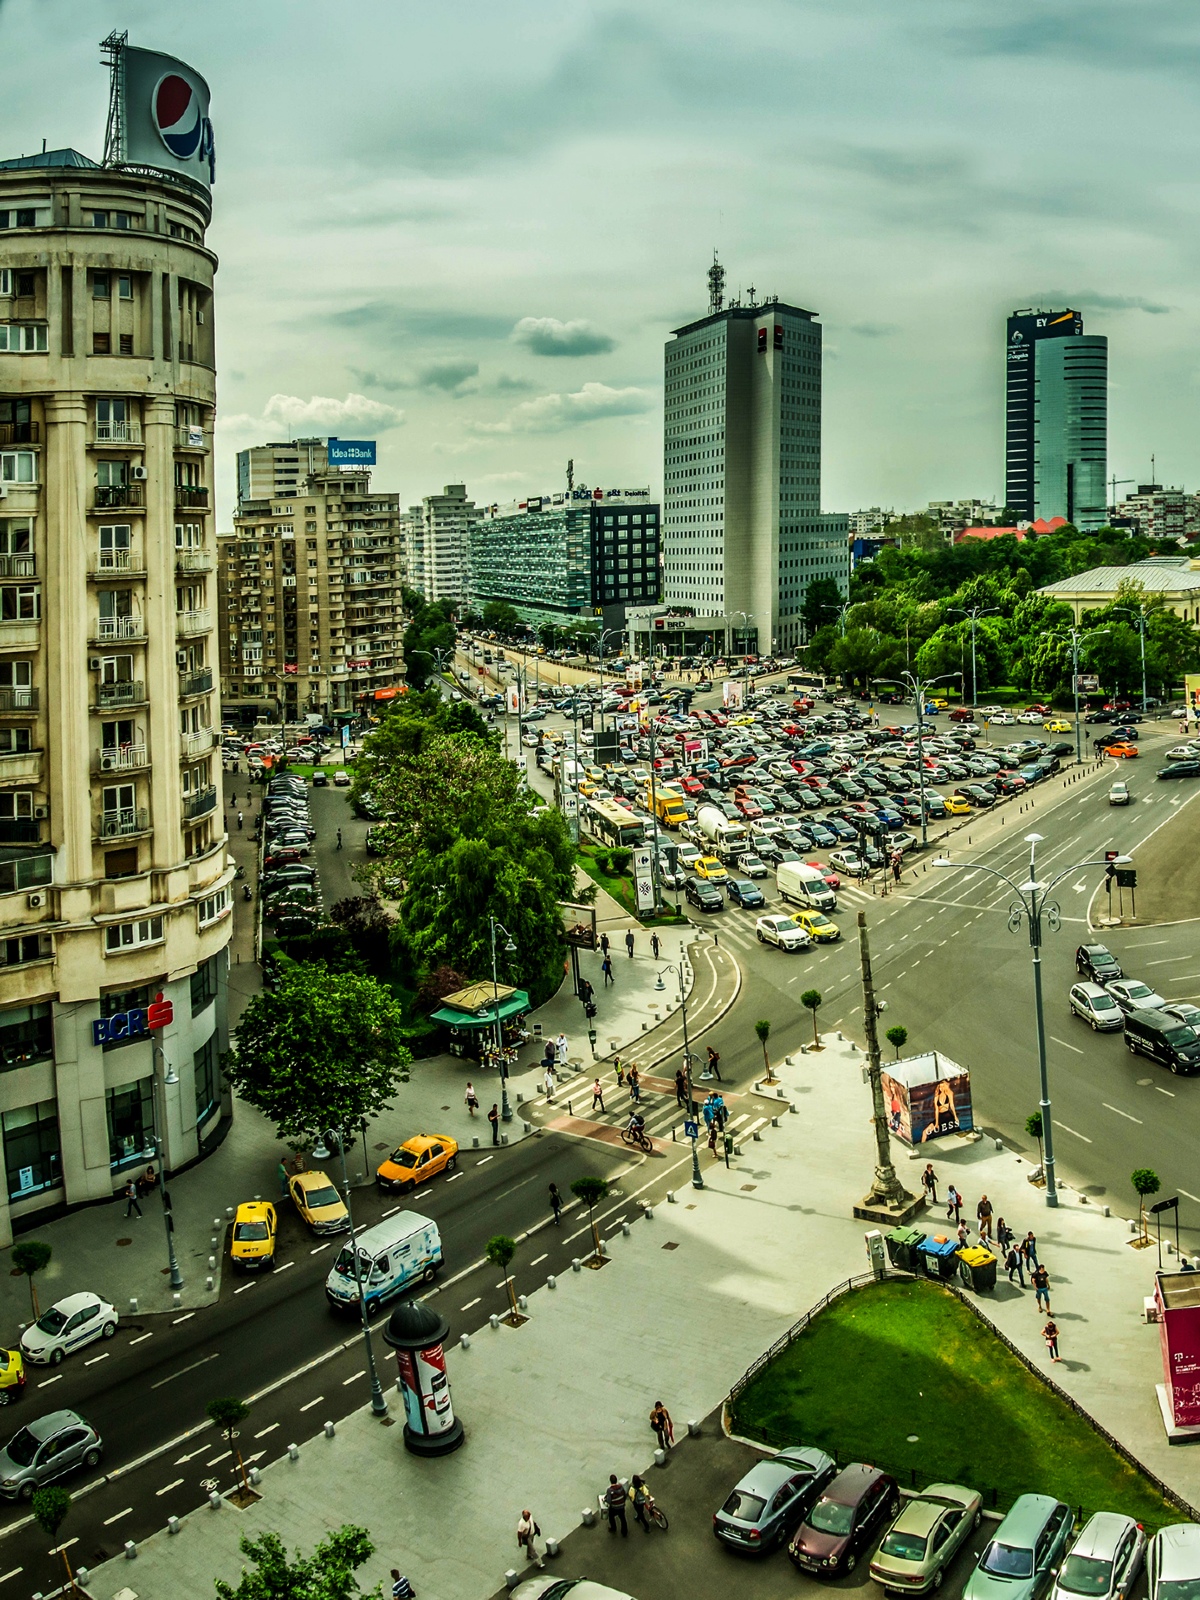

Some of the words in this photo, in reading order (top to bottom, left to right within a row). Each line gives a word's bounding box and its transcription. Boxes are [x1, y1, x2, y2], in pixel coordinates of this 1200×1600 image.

[1036, 318, 1047, 327] EY
[331, 448, 348, 458] Idea
[354, 448, 372, 458] Bank
[572, 489, 592, 499] BCR
[92, 1007, 146, 1047] BCR
[925, 1119, 960, 1136] GUESS
